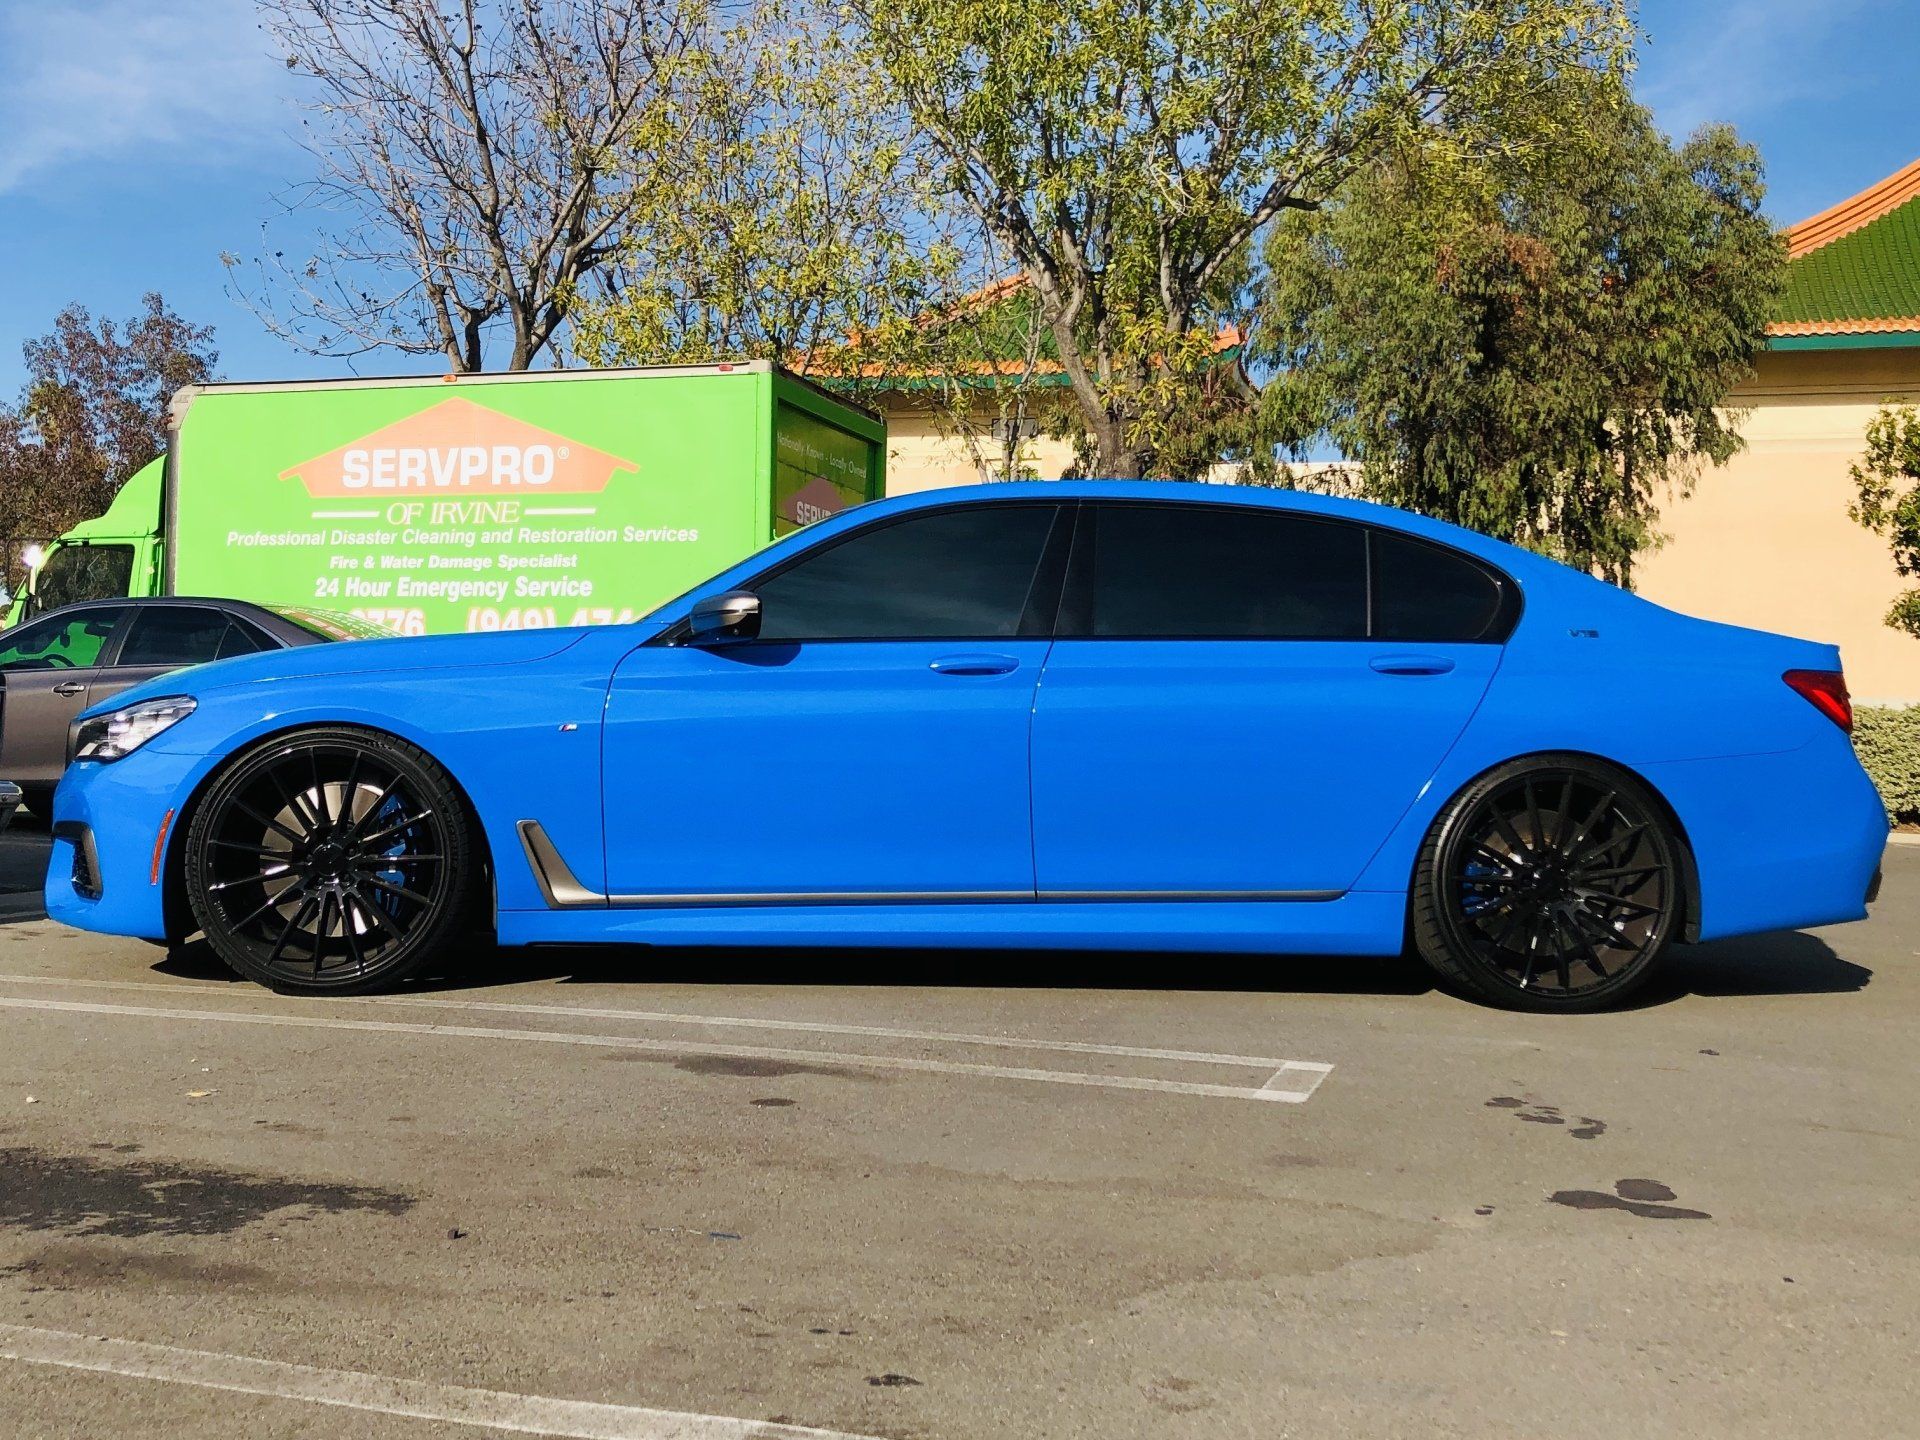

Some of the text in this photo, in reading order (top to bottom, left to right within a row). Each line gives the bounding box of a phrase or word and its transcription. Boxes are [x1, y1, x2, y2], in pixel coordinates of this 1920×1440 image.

[386, 501, 521, 526] OF IRVINE
[227, 526, 699, 547] Professional Disaster Cleaning and Restoration Services
[329, 553, 578, 571] Fire & Water Damage Specialist
[315, 575, 593, 602] 24 Hour Emergency Service
